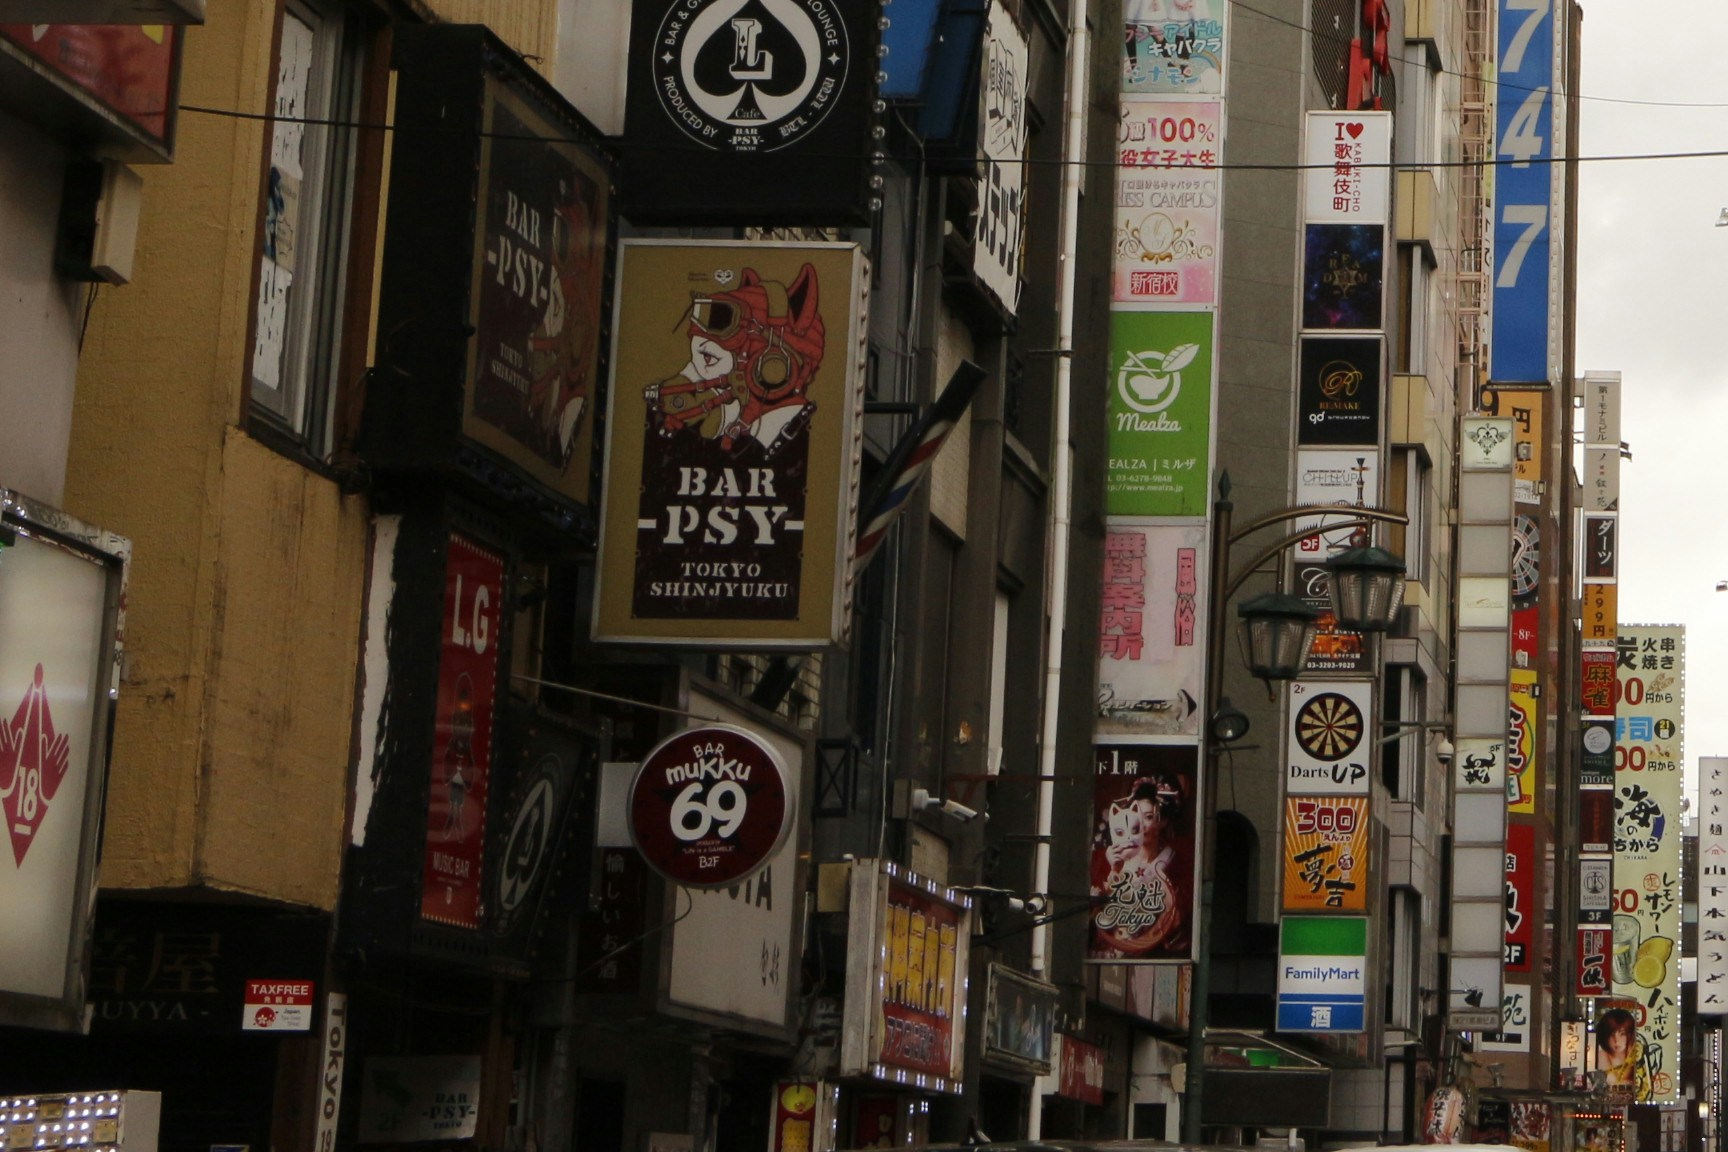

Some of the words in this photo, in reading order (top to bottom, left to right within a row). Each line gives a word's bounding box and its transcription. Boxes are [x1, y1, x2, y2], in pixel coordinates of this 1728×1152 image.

[664, 20, 682, 45] BAR
[678, 10, 690, 20] &
[1148, 38, 1222, 56] キャバクラ
[663, 76, 704, 128] PRODUCED
[702, 124, 718, 138] BY
[735, 127, 758, 135] BAR
[735, 107, 761, 119] Cafe
[1333, 143, 1352, 213] 歌舞伎町
[506, 190, 541, 249] BAR
[1131, 272, 1179, 294] 新宿校
[1116, 411, 1182, 432] Mealza
[677, 467, 777, 497] BAR
[1597, 520, 1614, 565] ダーツ
[681, 562, 761, 578] TOKYO
[650, 581, 789, 599] SHINJYUKU
[1294, 684, 1306, 694] 2F
[1584, 664, 1614, 708] 麻雀
[693, 742, 725, 759] BAR
[1291, 765, 1329, 778] Darts
[1332, 763, 1366, 784] UP
[1580, 774, 1613, 784] more
[15, 765, 40, 819] 18
[670, 780, 747, 841] 69
[1297, 802, 1355, 833] 300
[432, 851, 453, 874] MUSIC
[455, 854, 470, 878] BAR
[699, 855, 720, 869] B2F
[1096, 904, 1157, 935] Tokyo
[1588, 911, 1603, 921] 3F
[1285, 966, 1360, 983] FamilyMart
[251, 984, 309, 996] TAXFREE
[1311, 1006, 1332, 1028] 酒
[435, 1093, 468, 1105] BAR
